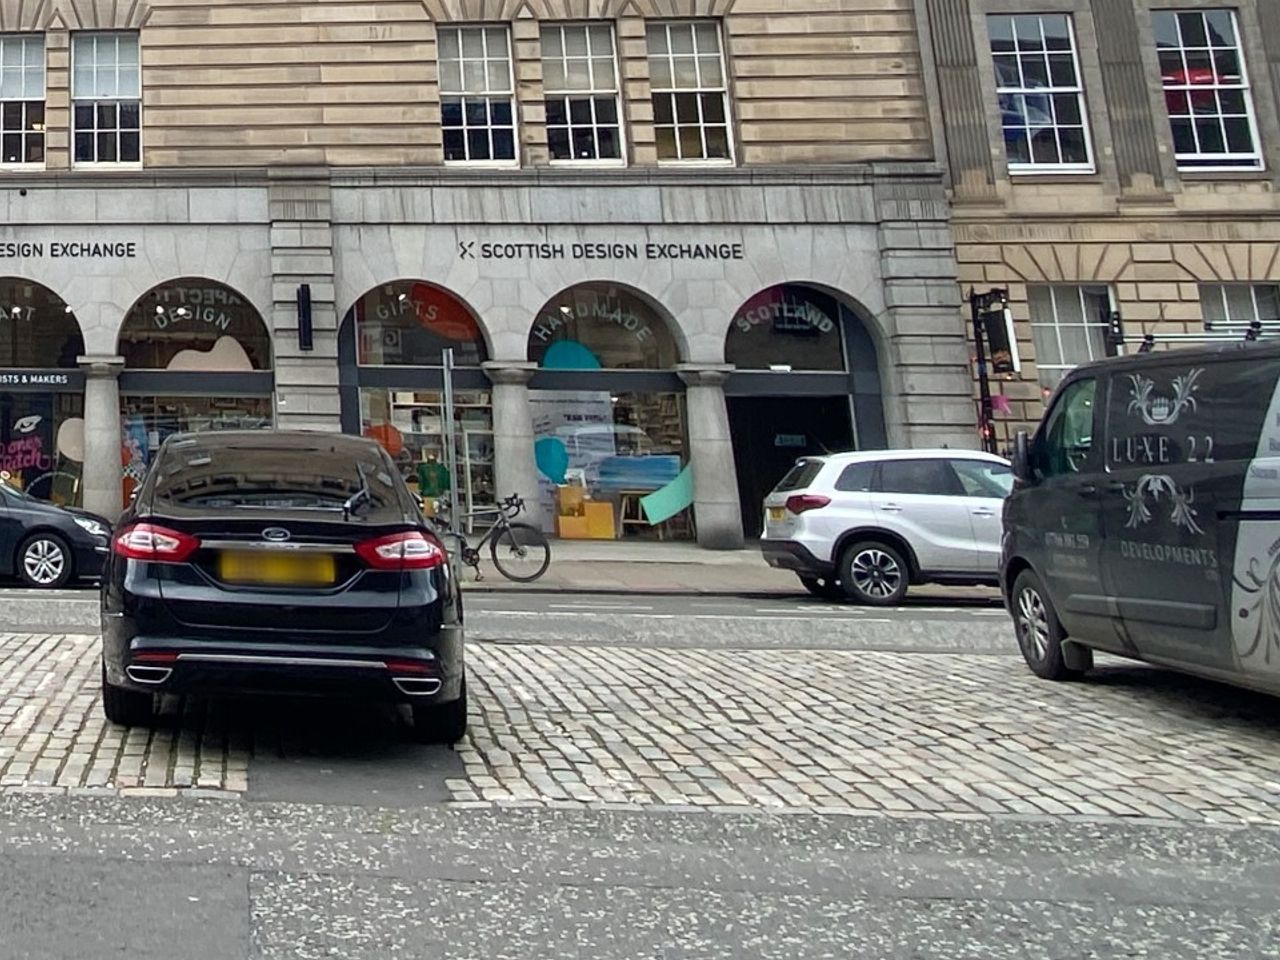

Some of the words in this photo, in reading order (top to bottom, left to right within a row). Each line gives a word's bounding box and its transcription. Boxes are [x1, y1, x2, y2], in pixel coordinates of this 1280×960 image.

[50, 242, 137, 258] EXCHANGE
[481, 243, 564, 259] SCOTTISH
[572, 244, 638, 259] DESIGN
[645, 243, 744, 259] EXCHANGE
[154, 304, 231, 330] DESIGN
[376, 299, 439, 320] GIFTS
[534, 303, 652, 341] HANDMADE
[737, 302, 834, 333] SCOTLAND
[21, 374, 28, 383] &
[30, 375, 68, 384] MAKERS
[1113, 437, 1170, 462] LUXE
[1187, 436, 1215, 463] 22
[1121, 540, 1218, 567] DEVELOPMENTS
